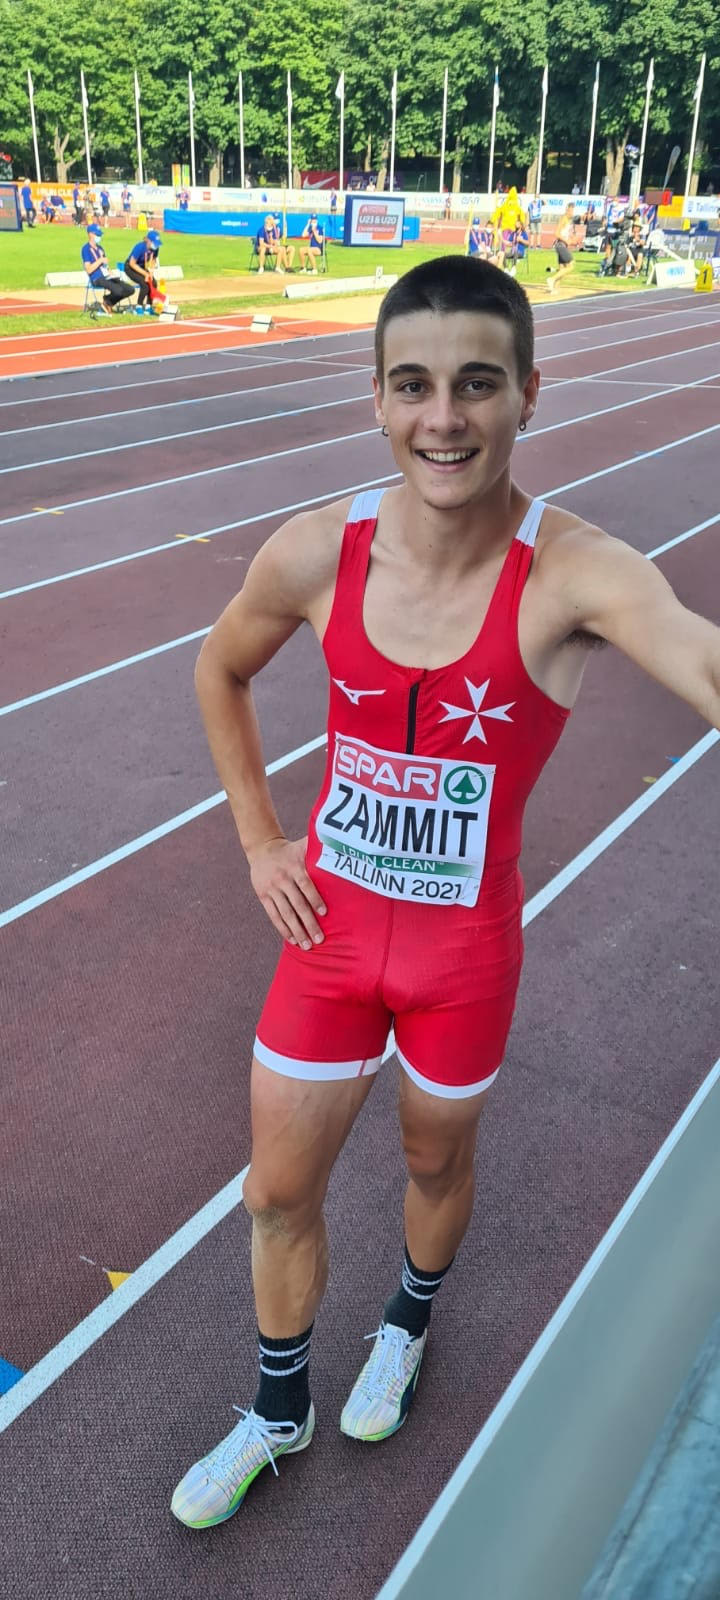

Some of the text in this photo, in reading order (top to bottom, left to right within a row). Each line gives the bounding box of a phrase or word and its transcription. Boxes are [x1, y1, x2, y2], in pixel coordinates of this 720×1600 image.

[359, 215, 374, 224] U23
[381, 215, 397, 225] U20
[703, 269, 708, 284] 1
[338, 749, 435, 794] SPAR
[324, 784, 478, 857] ZAMMIT
[333, 851, 463, 900] TALLINN 2021
